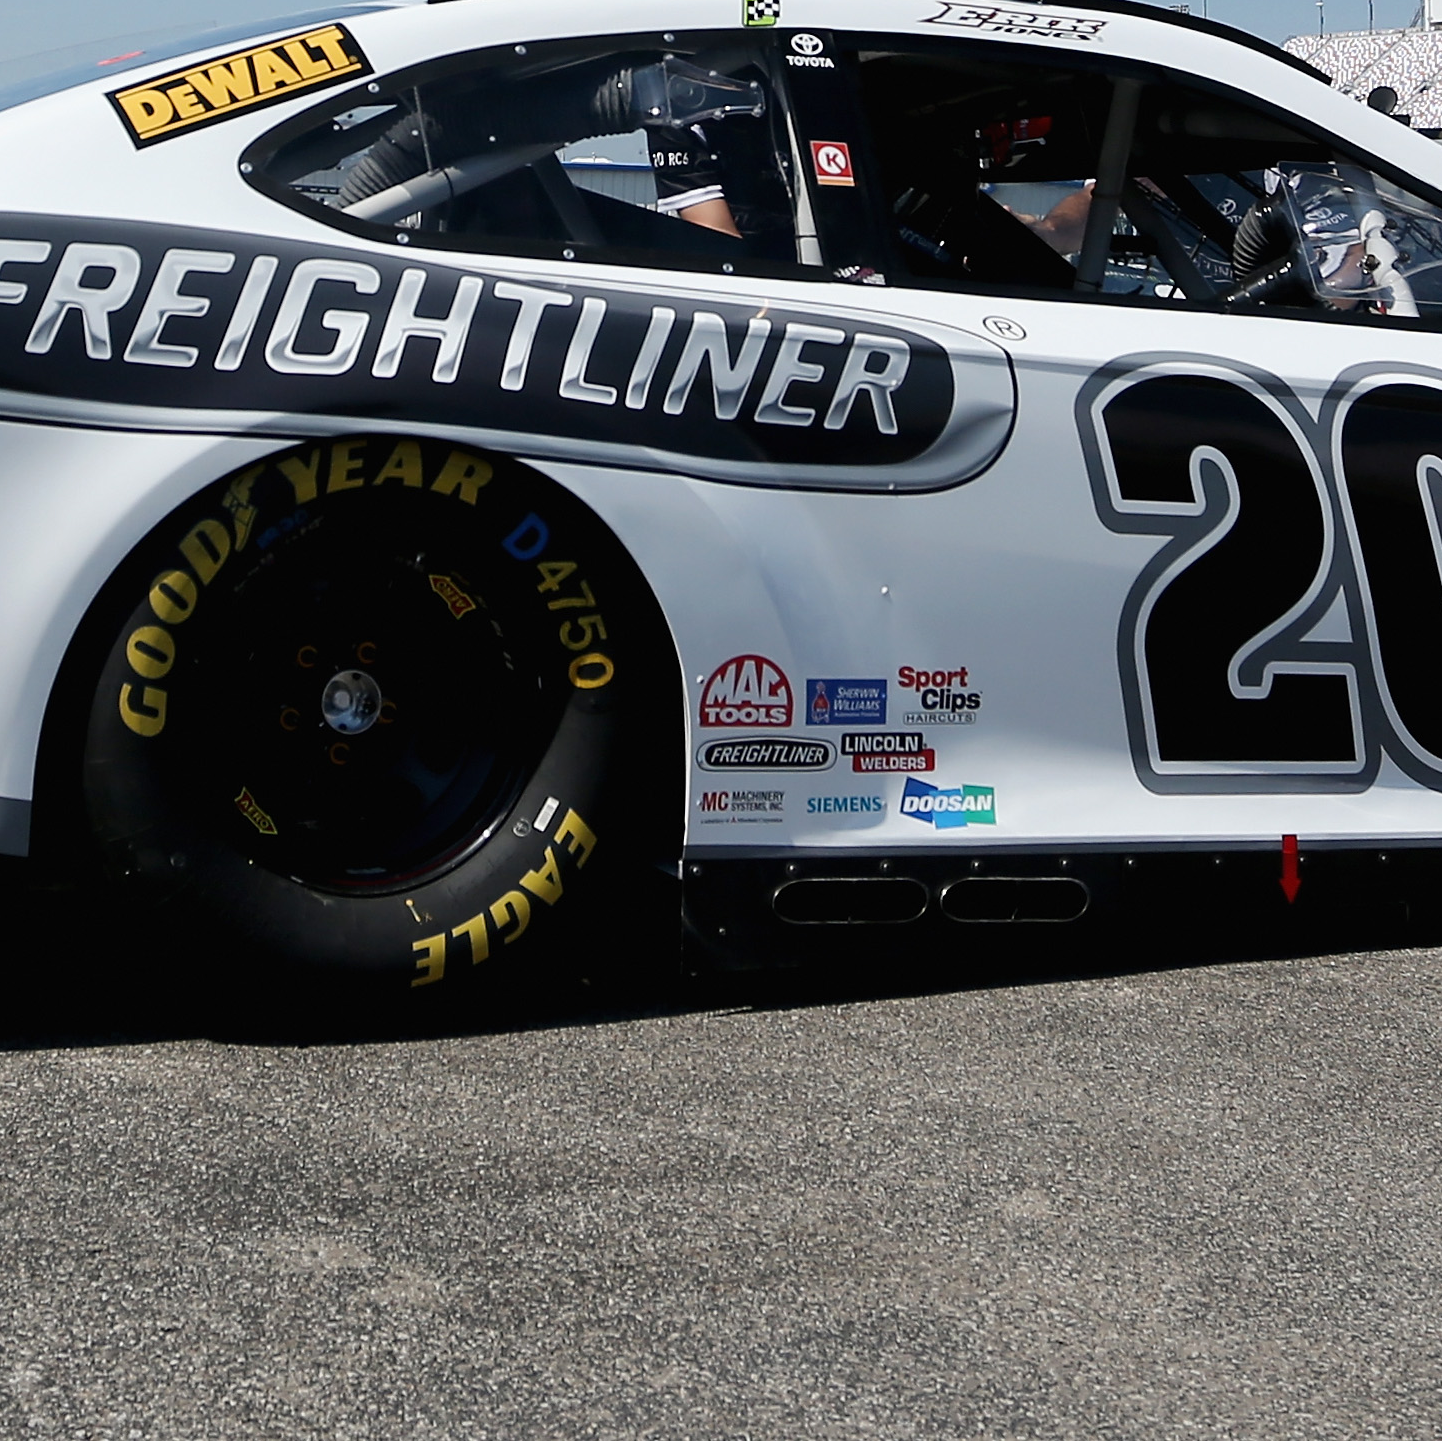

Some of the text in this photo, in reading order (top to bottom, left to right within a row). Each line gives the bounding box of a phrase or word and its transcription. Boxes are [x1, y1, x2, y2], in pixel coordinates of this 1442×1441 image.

[920, 1, 1109, 33] ERIK
[786, 55, 835, 69] TOYOTA
[706, 659, 789, 707] MAC
[898, 665, 968, 692] Sport
[837, 686, 880, 698] SHERWIN
[921, 688, 981, 713] Clips
[834, 699, 881, 710] WILLIAMS
[705, 708, 788, 724] TOOLS
[906, 713, 974, 723] HAIRCUTS
[845, 735, 919, 753] LINCOLN
[710, 745, 825, 763] FREIGHTLINER
[860, 756, 926, 770] WELDERS
[701, 791, 729, 812] MC
[732, 791, 785, 802] MACHINERY
[806, 796, 882, 814] SIEMENS
[902, 795, 993, 813] DOOSAN
[411, 808, 597, 987] EAGLE
